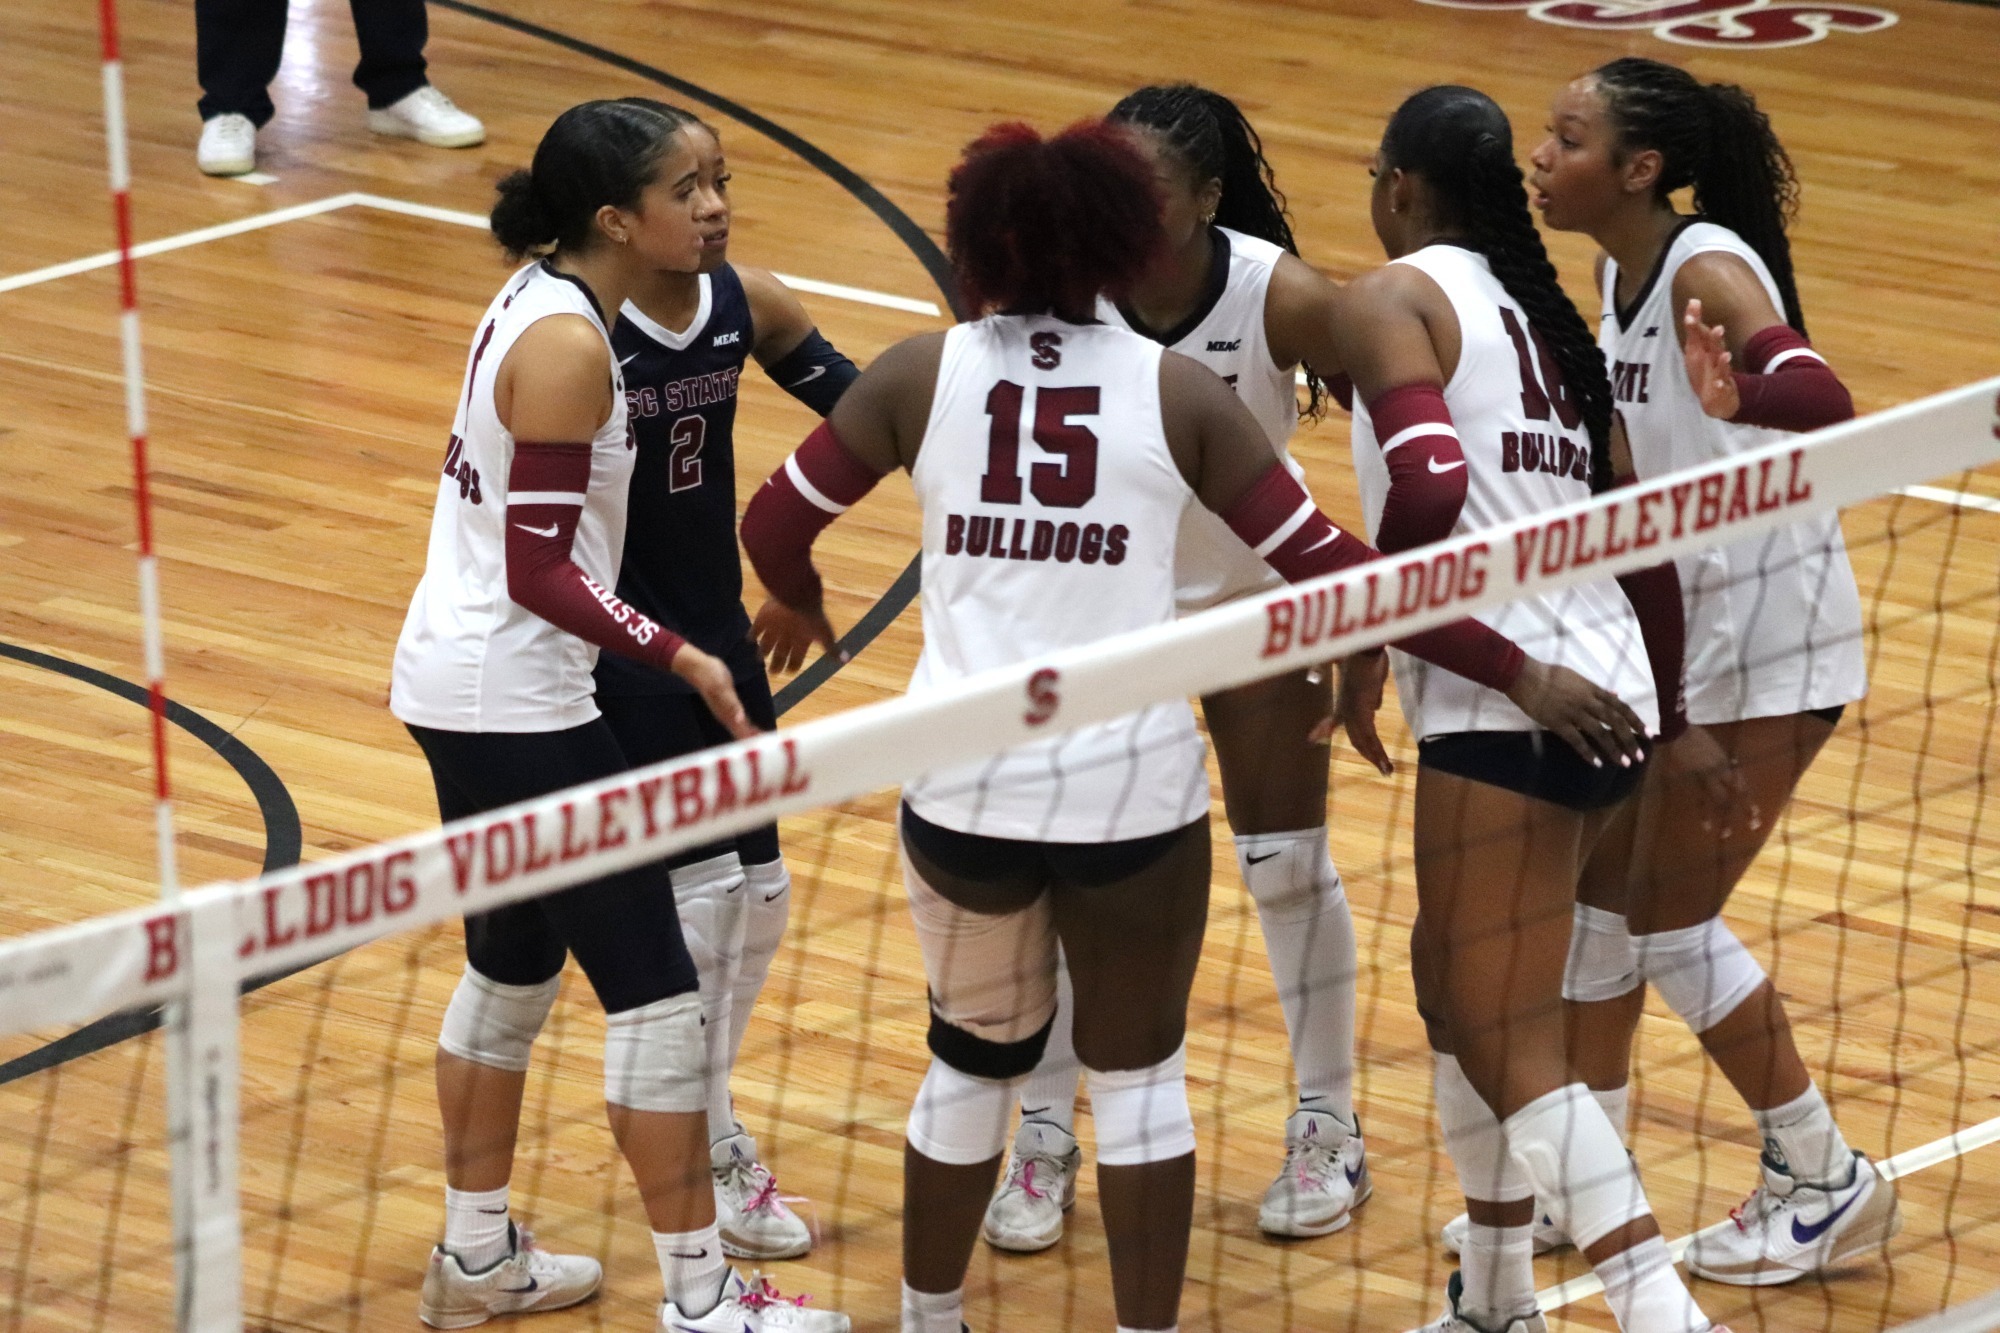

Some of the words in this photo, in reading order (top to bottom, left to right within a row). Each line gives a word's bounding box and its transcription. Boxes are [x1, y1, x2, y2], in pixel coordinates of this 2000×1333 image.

[713, 331, 740, 347] MEAC
[1030, 332, 1062, 371] S
[1206, 339, 1242, 352] MEAC
[625, 387, 659, 419] SC
[665, 366, 739, 412] STATE
[669, 414, 706, 493] 2
[980, 379, 1102, 509] 15
[945, 514, 1130, 566] BULLDOGS
[1261, 542, 1490, 659] BULLDOG
[1514, 448, 1812, 585] VOLLEYBALL
[1024, 667, 1061, 726] S
[143, 850, 417, 985] BLDOG
[445, 739, 811, 893] VOLLEYBALL
